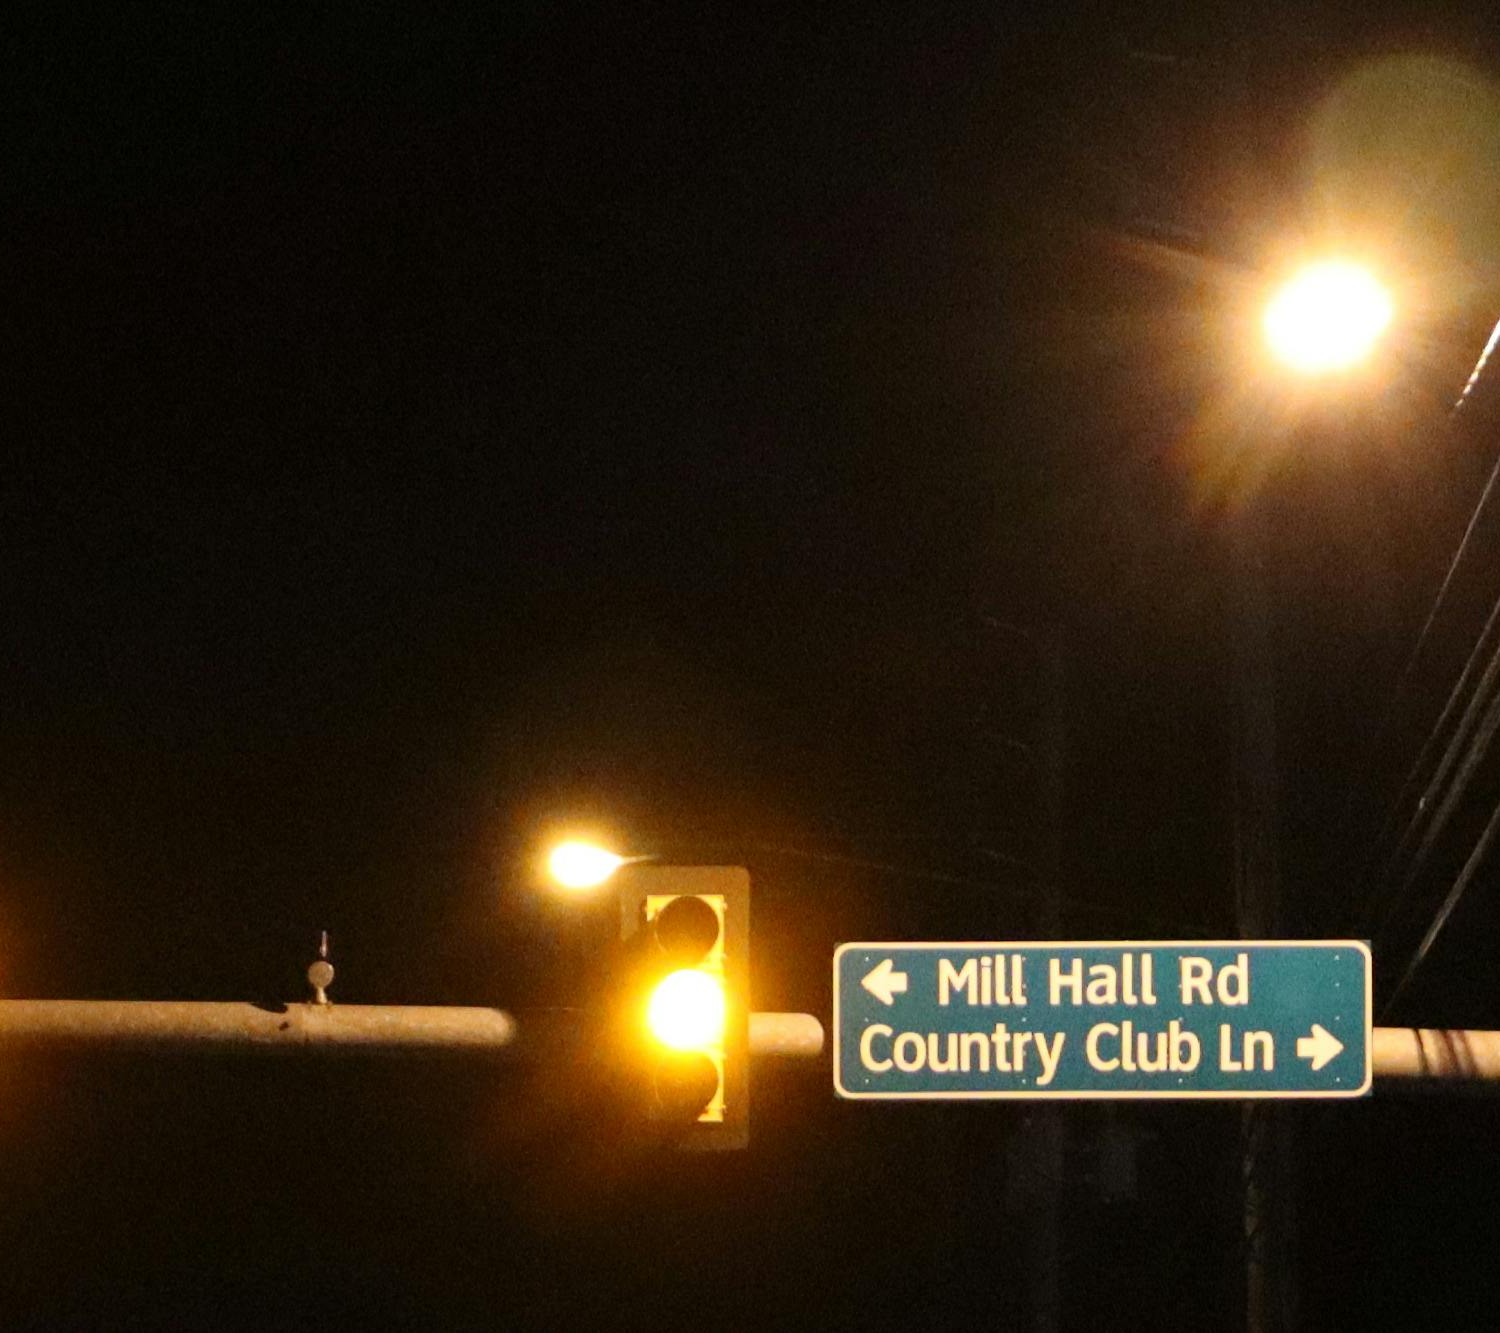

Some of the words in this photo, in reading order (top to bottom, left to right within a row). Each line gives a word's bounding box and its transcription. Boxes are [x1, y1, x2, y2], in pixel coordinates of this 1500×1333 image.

[937, 954, 1028, 1006] Mill
[1048, 953, 1157, 1006] Hall
[1180, 953, 1250, 1005] Rd
[859, 1021, 1066, 1085] Country
[1086, 1021, 1201, 1074] Club
[1219, 1023, 1275, 1073] Ln
